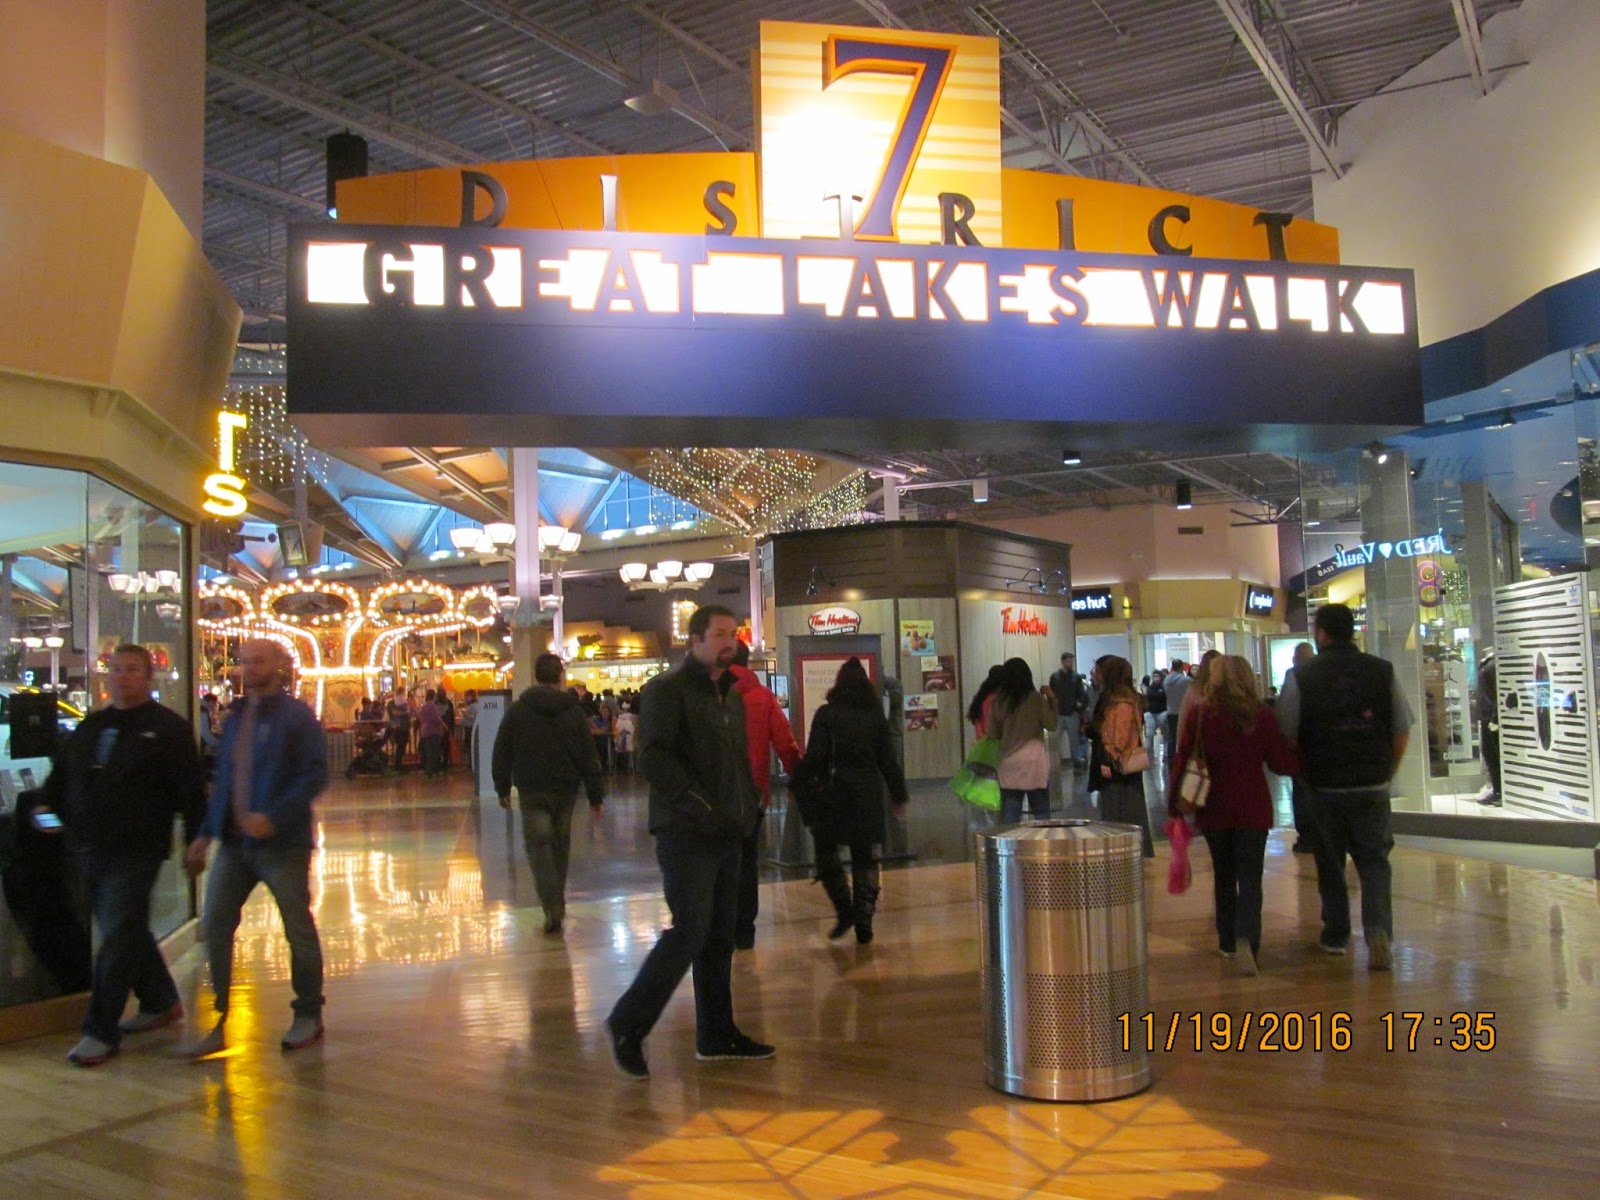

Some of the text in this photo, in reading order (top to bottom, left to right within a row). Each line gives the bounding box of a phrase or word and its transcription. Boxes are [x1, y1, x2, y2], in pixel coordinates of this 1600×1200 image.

[824, 34, 957, 241] 7
[460, 170, 1293, 260] DISTRICT
[363, 242, 1385, 334] GREAT LAKES WALK
[1087, 596, 1107, 610] hut
[810, 613, 859, 626] Tim Hortons
[1001, 607, 1048, 636] Tim Hortons
[483, 701, 499, 710] ATM
